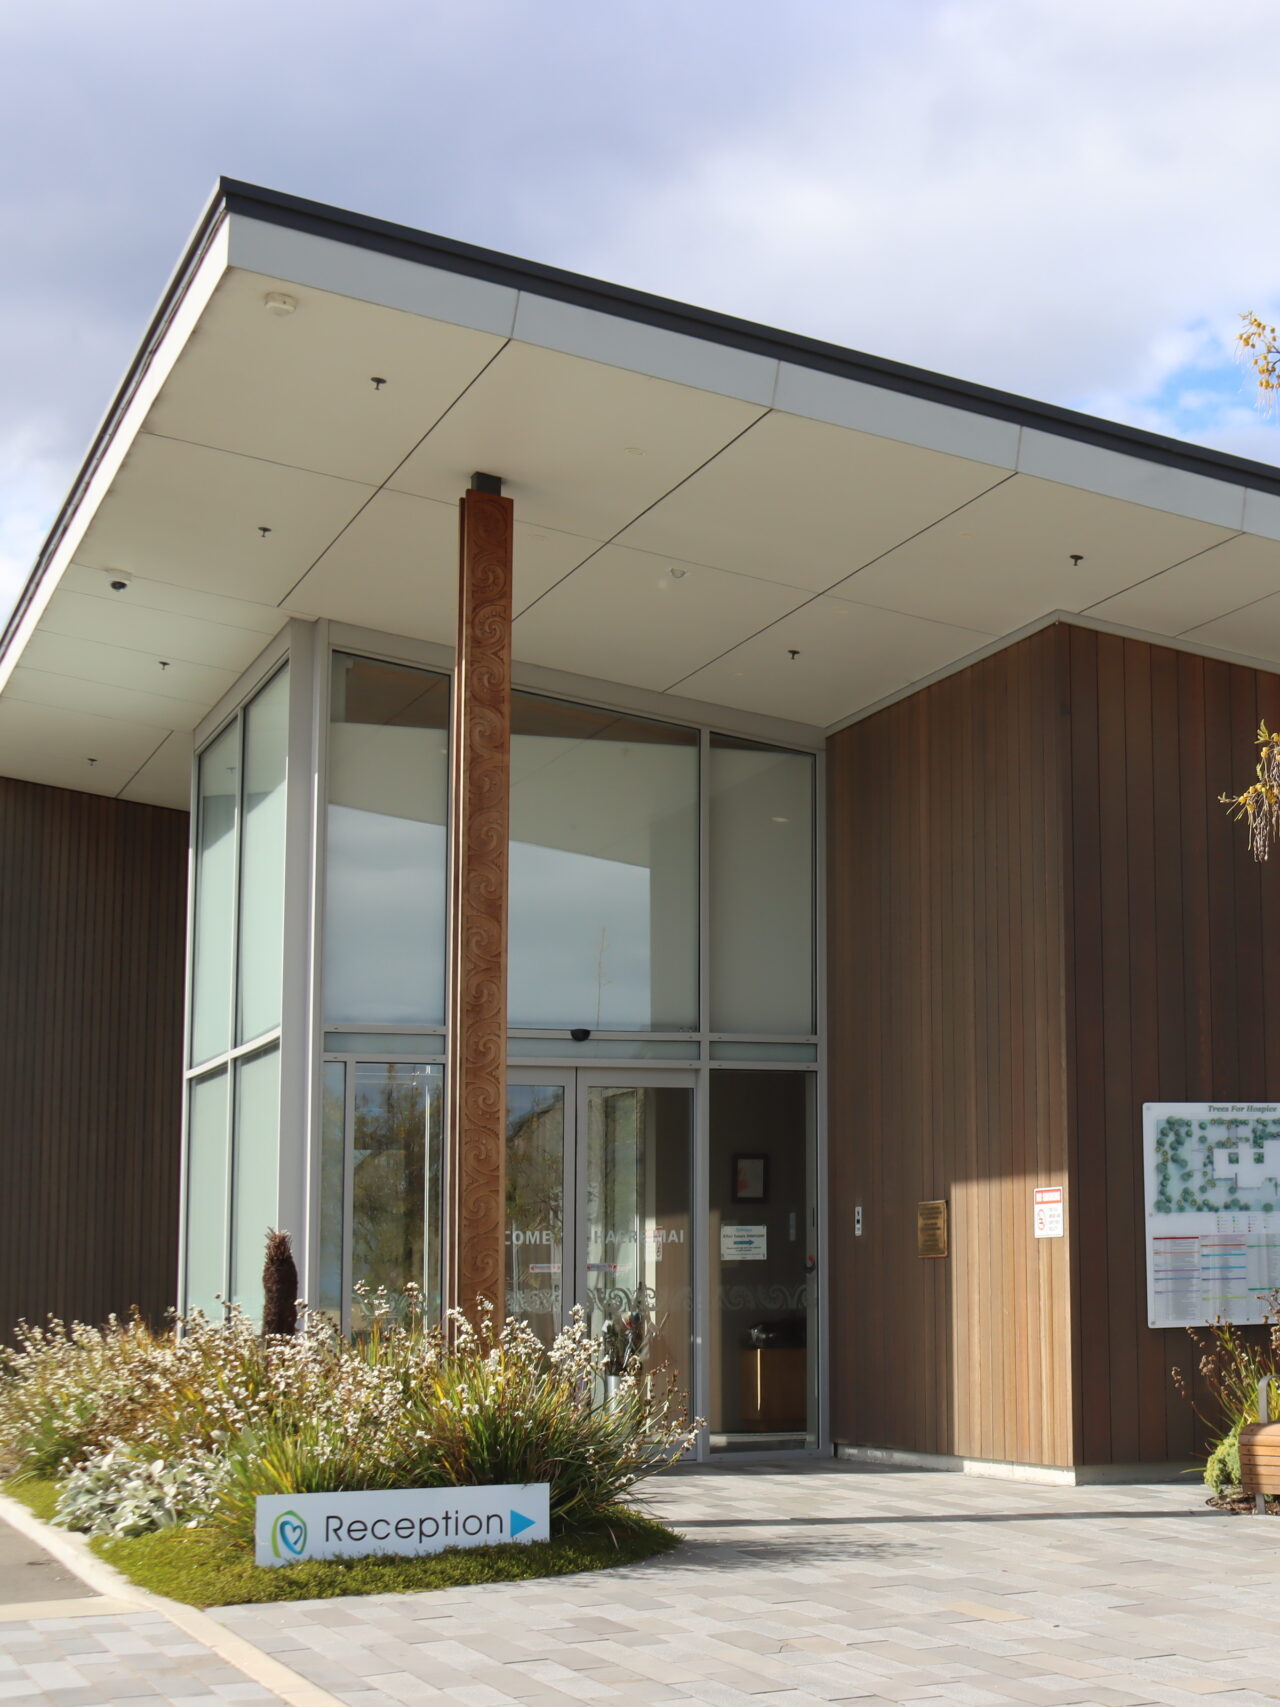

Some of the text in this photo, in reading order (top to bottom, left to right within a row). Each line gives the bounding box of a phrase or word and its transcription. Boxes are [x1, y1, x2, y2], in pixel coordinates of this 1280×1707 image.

[1208, 1105, 1277, 1114] Trees For Hospice
[325, 1510, 503, 1544] Reception
